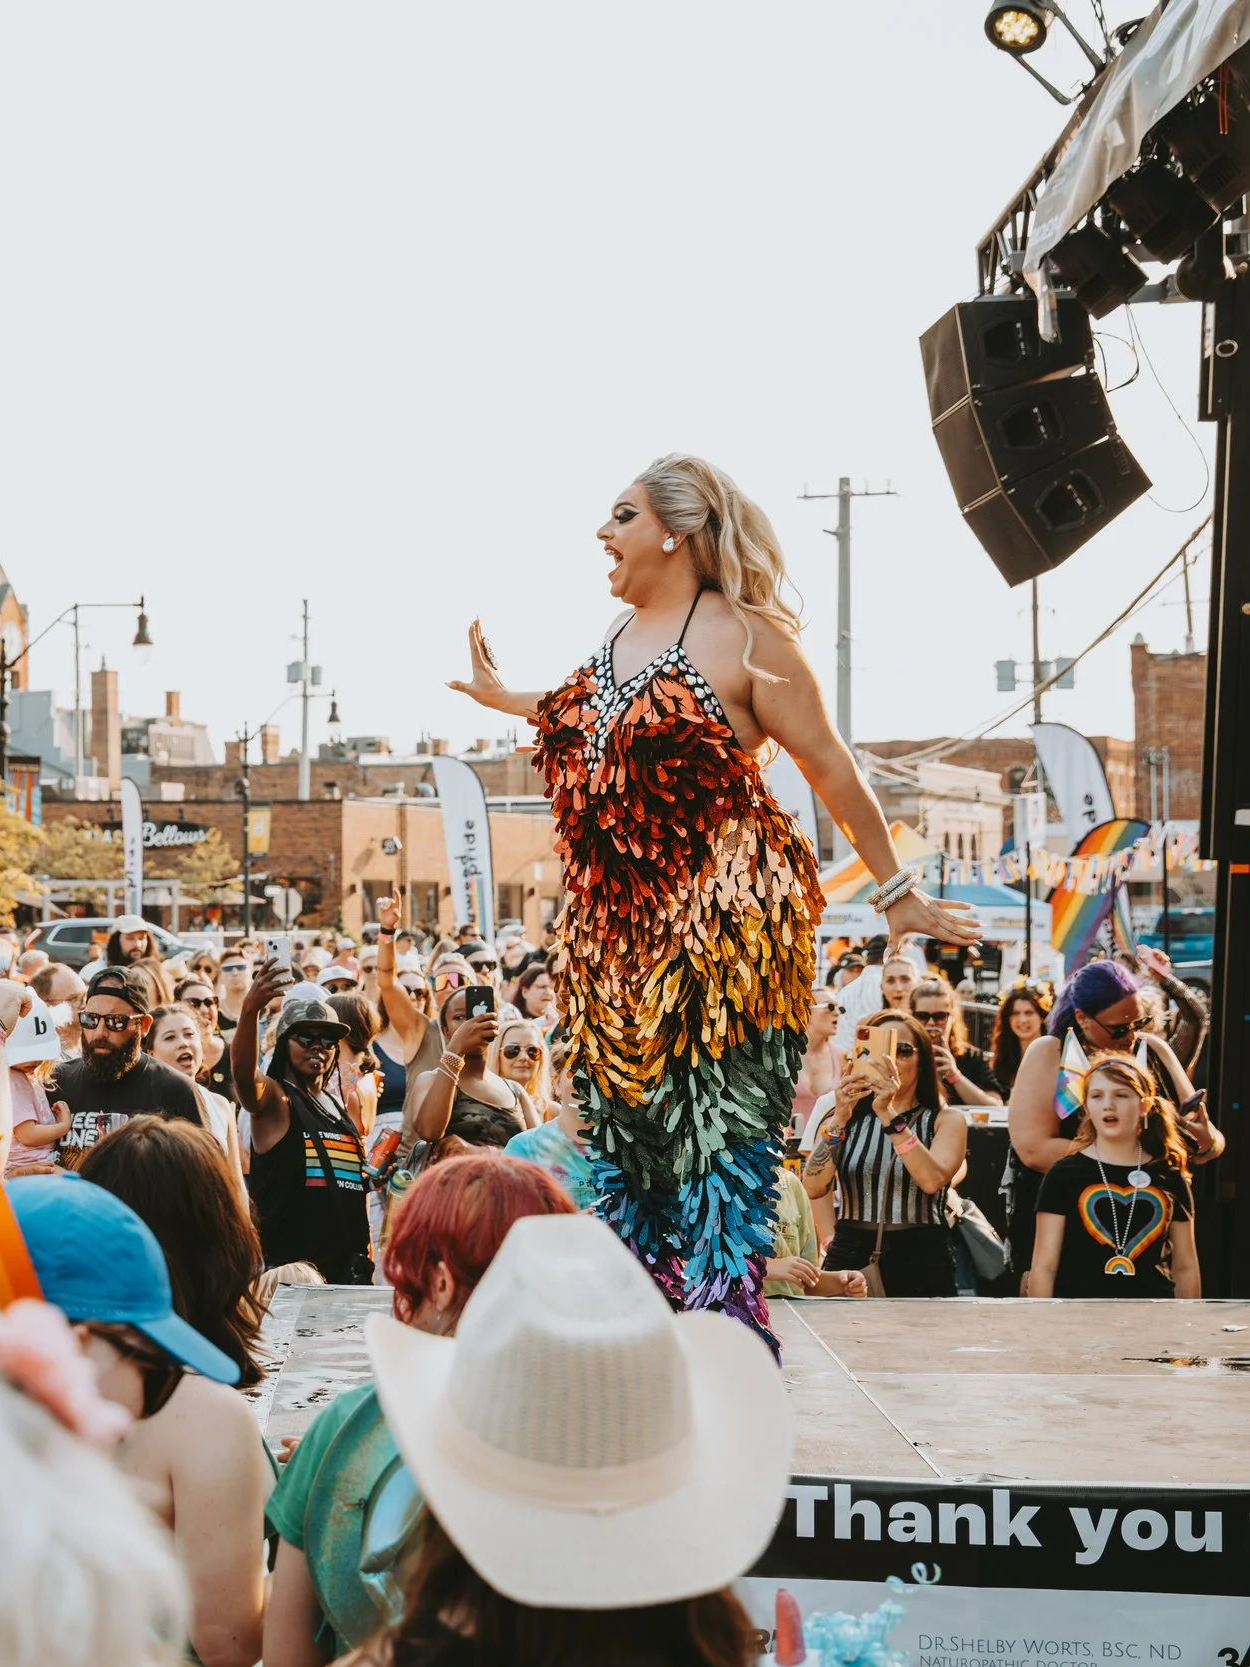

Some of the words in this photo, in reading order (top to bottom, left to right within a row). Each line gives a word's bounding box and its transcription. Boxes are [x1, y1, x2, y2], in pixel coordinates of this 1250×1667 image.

[142, 821, 206, 847] Bellows
[34, 1016, 47, 1036] b
[786, 1484, 1043, 1547] Thank
[1069, 1507, 1223, 1566] you
[919, 1655, 1030, 1667] NATUROPATHIC
[1150, 1643, 1182, 1661] ND
